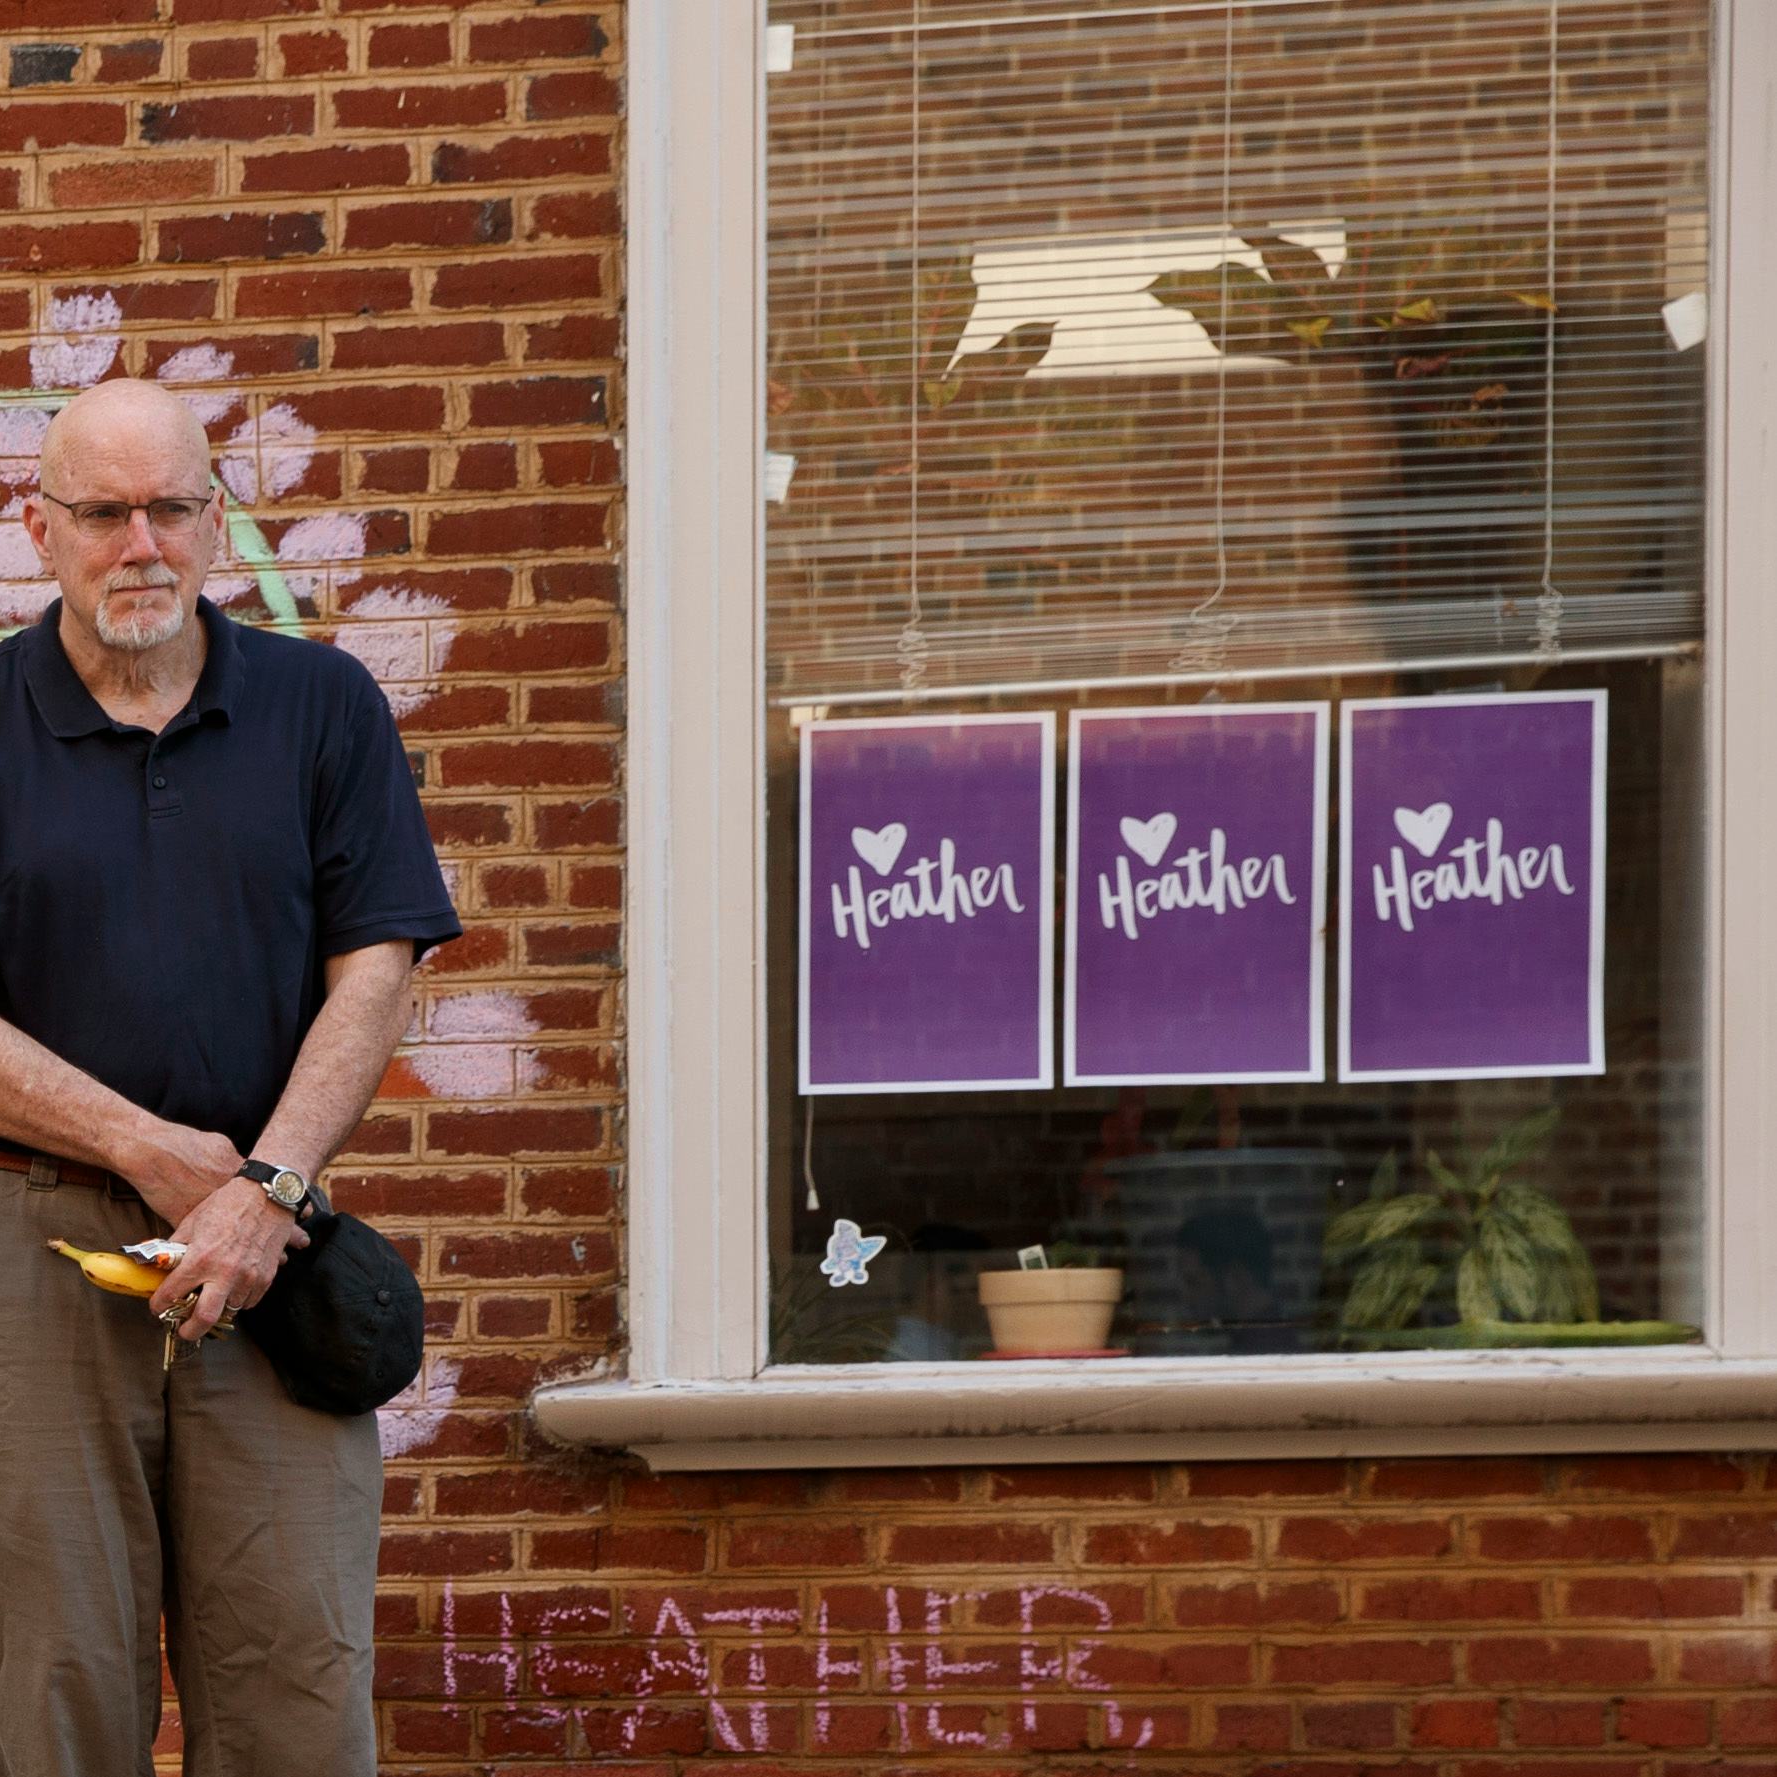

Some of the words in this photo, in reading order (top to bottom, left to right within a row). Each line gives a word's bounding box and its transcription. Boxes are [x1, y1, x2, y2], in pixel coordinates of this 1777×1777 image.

[831, 838, 1025, 948] Heather
[1099, 828, 1297, 940] Heather
[1373, 817, 1575, 931] Heather
